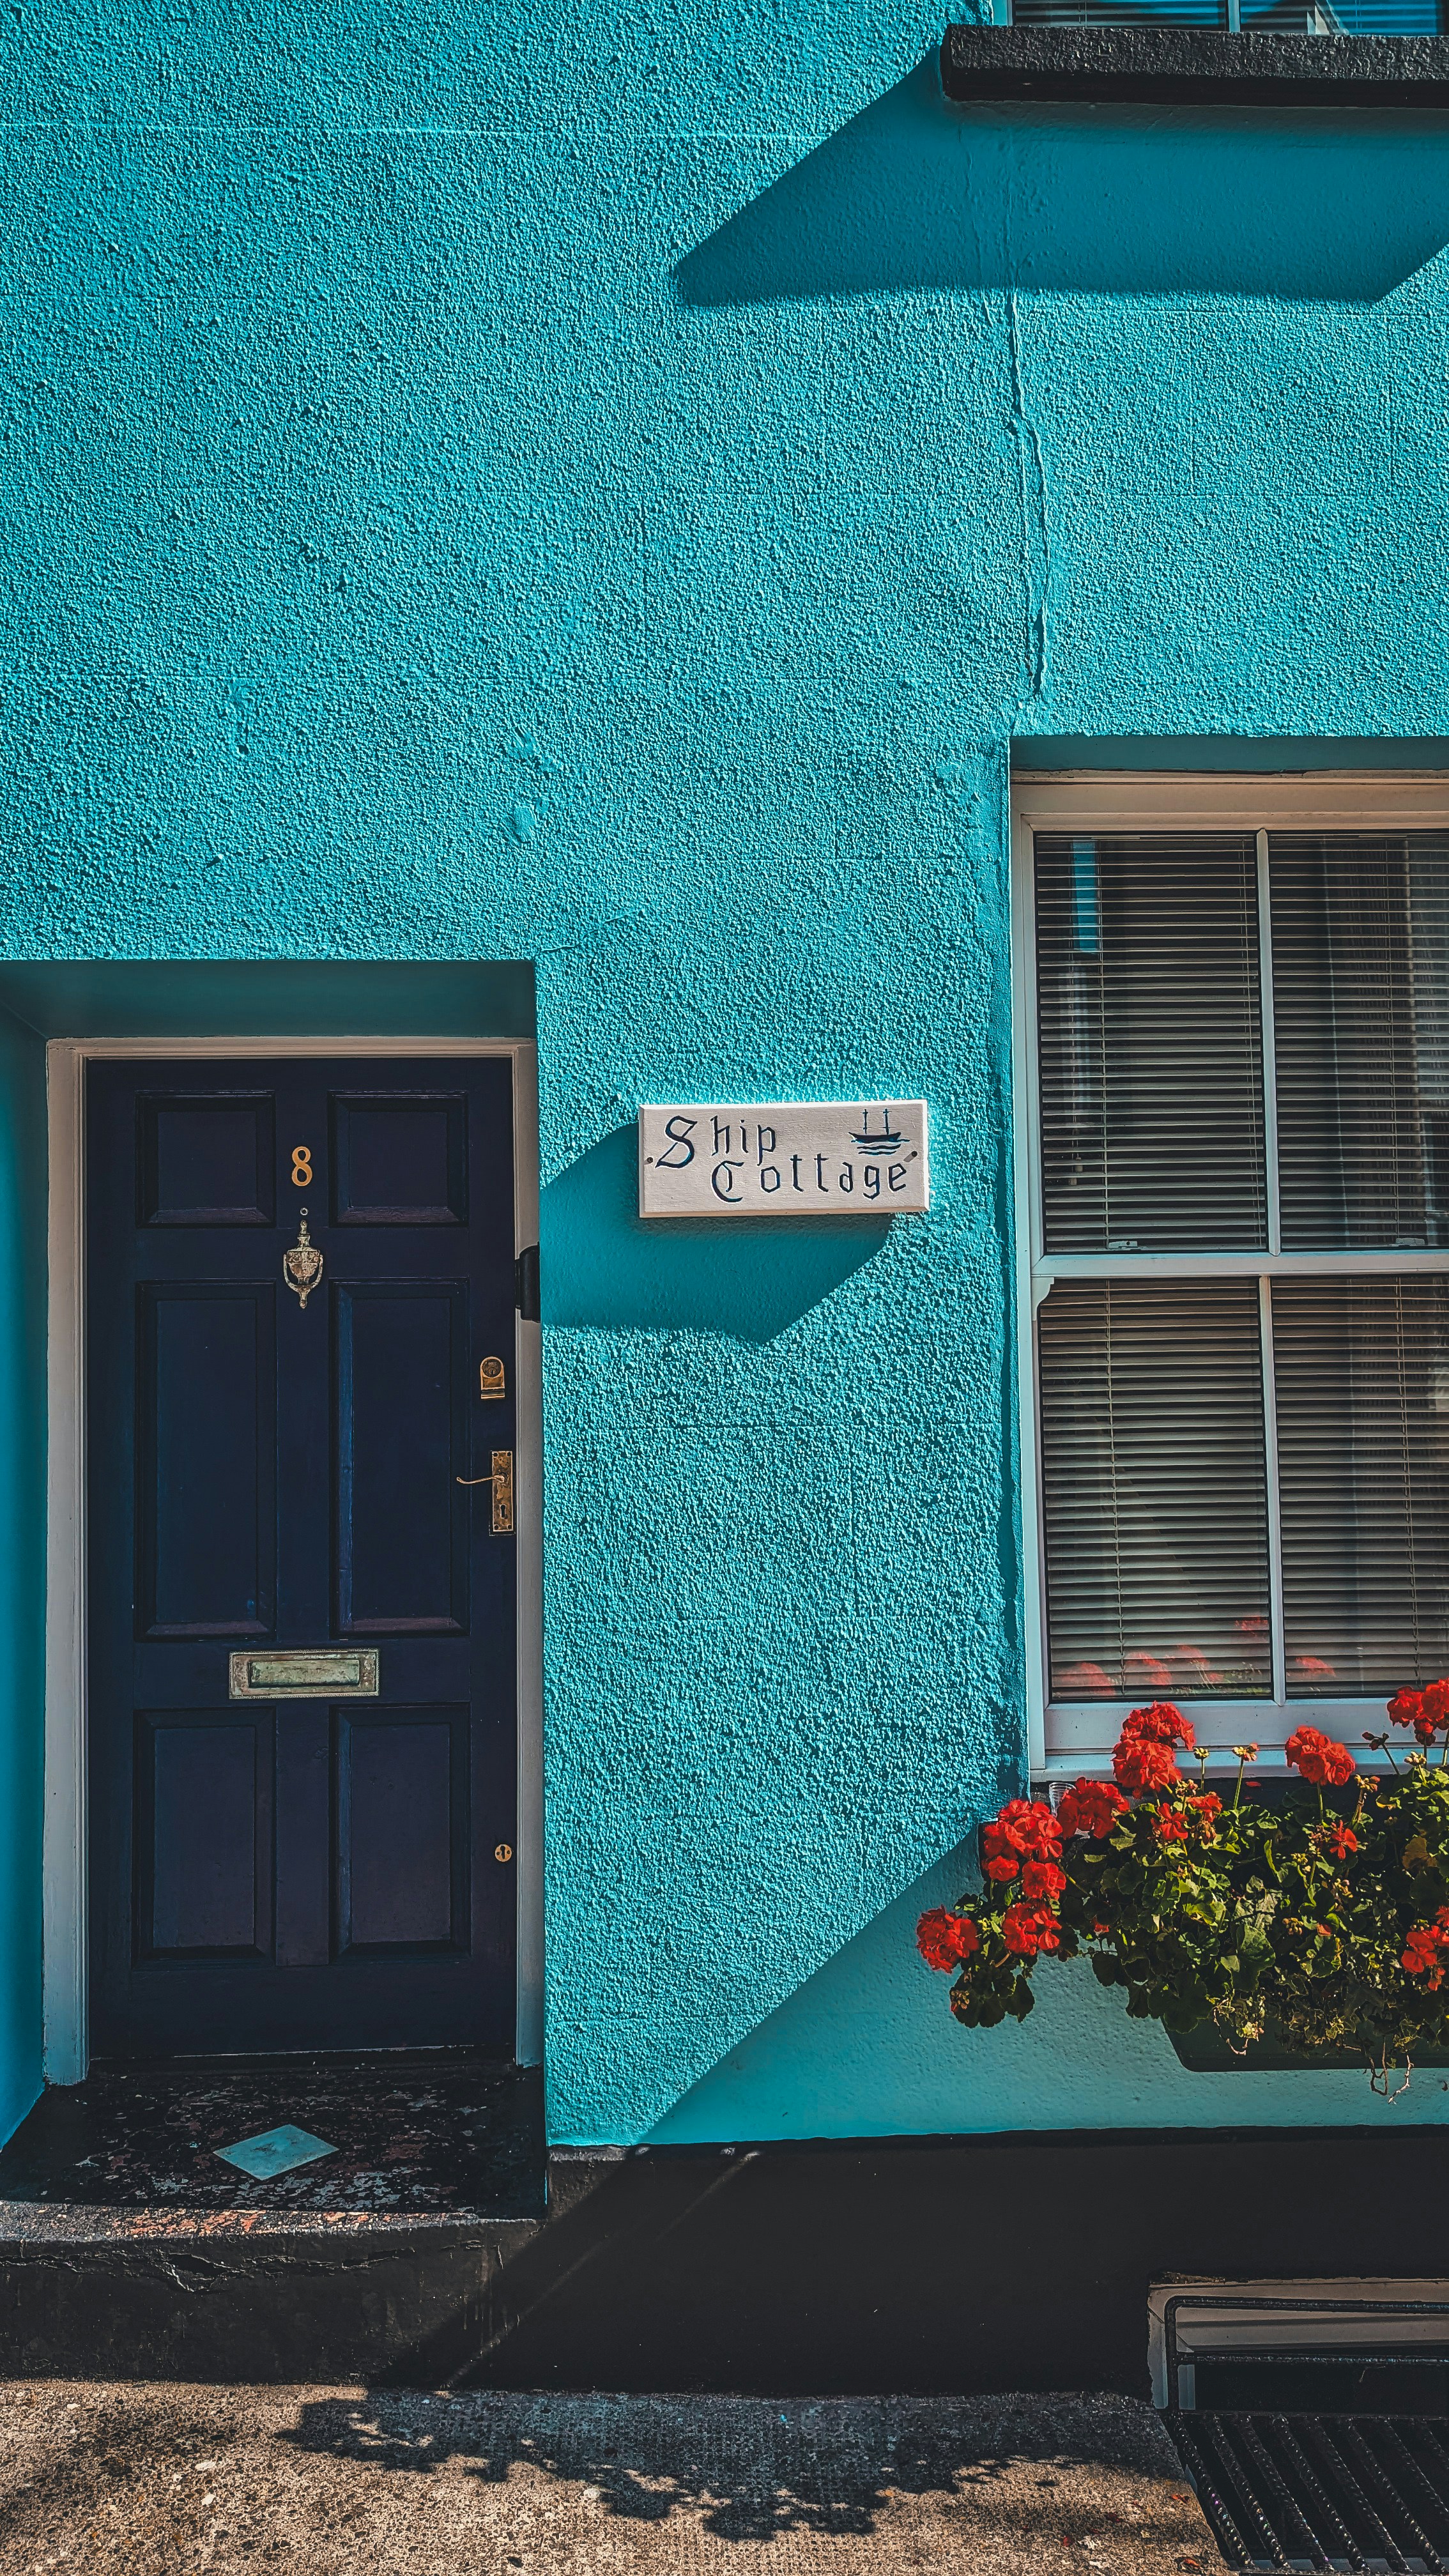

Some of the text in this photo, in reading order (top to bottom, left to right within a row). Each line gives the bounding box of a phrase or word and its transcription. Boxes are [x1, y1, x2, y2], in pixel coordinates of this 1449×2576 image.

[291, 1146, 312, 1186] 8
[655, 1115, 777, 1169] Ship
[711, 1153, 907, 1202] Cottage
